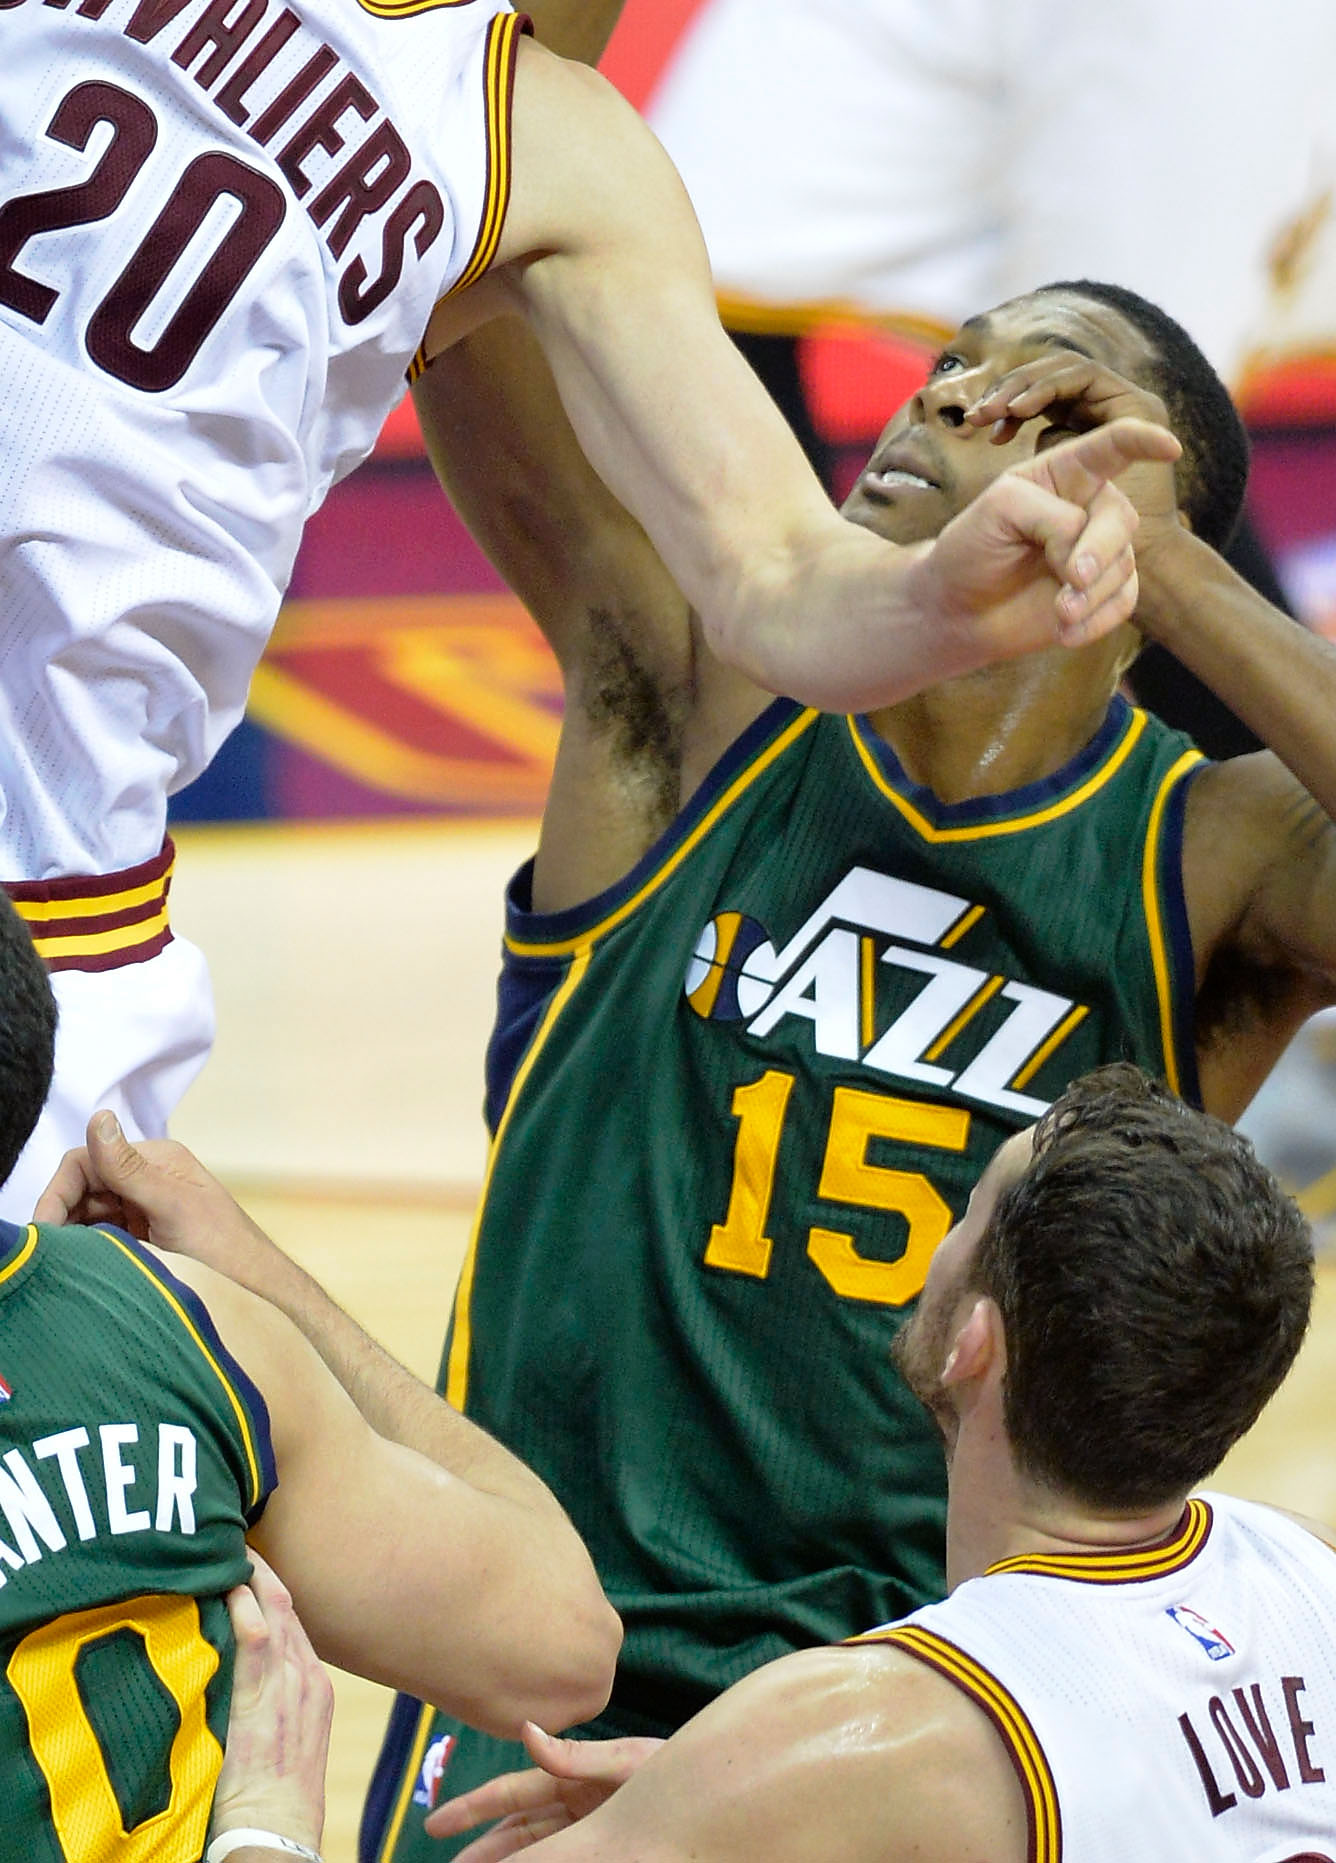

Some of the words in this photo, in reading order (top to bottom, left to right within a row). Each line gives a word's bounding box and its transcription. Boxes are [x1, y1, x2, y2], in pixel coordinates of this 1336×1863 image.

[736, 866, 1090, 1118] JAZZ
[704, 1069, 970, 1307] 15
[7, 1594, 224, 1863] 0
[1177, 1676, 1326, 1817] LOVE
